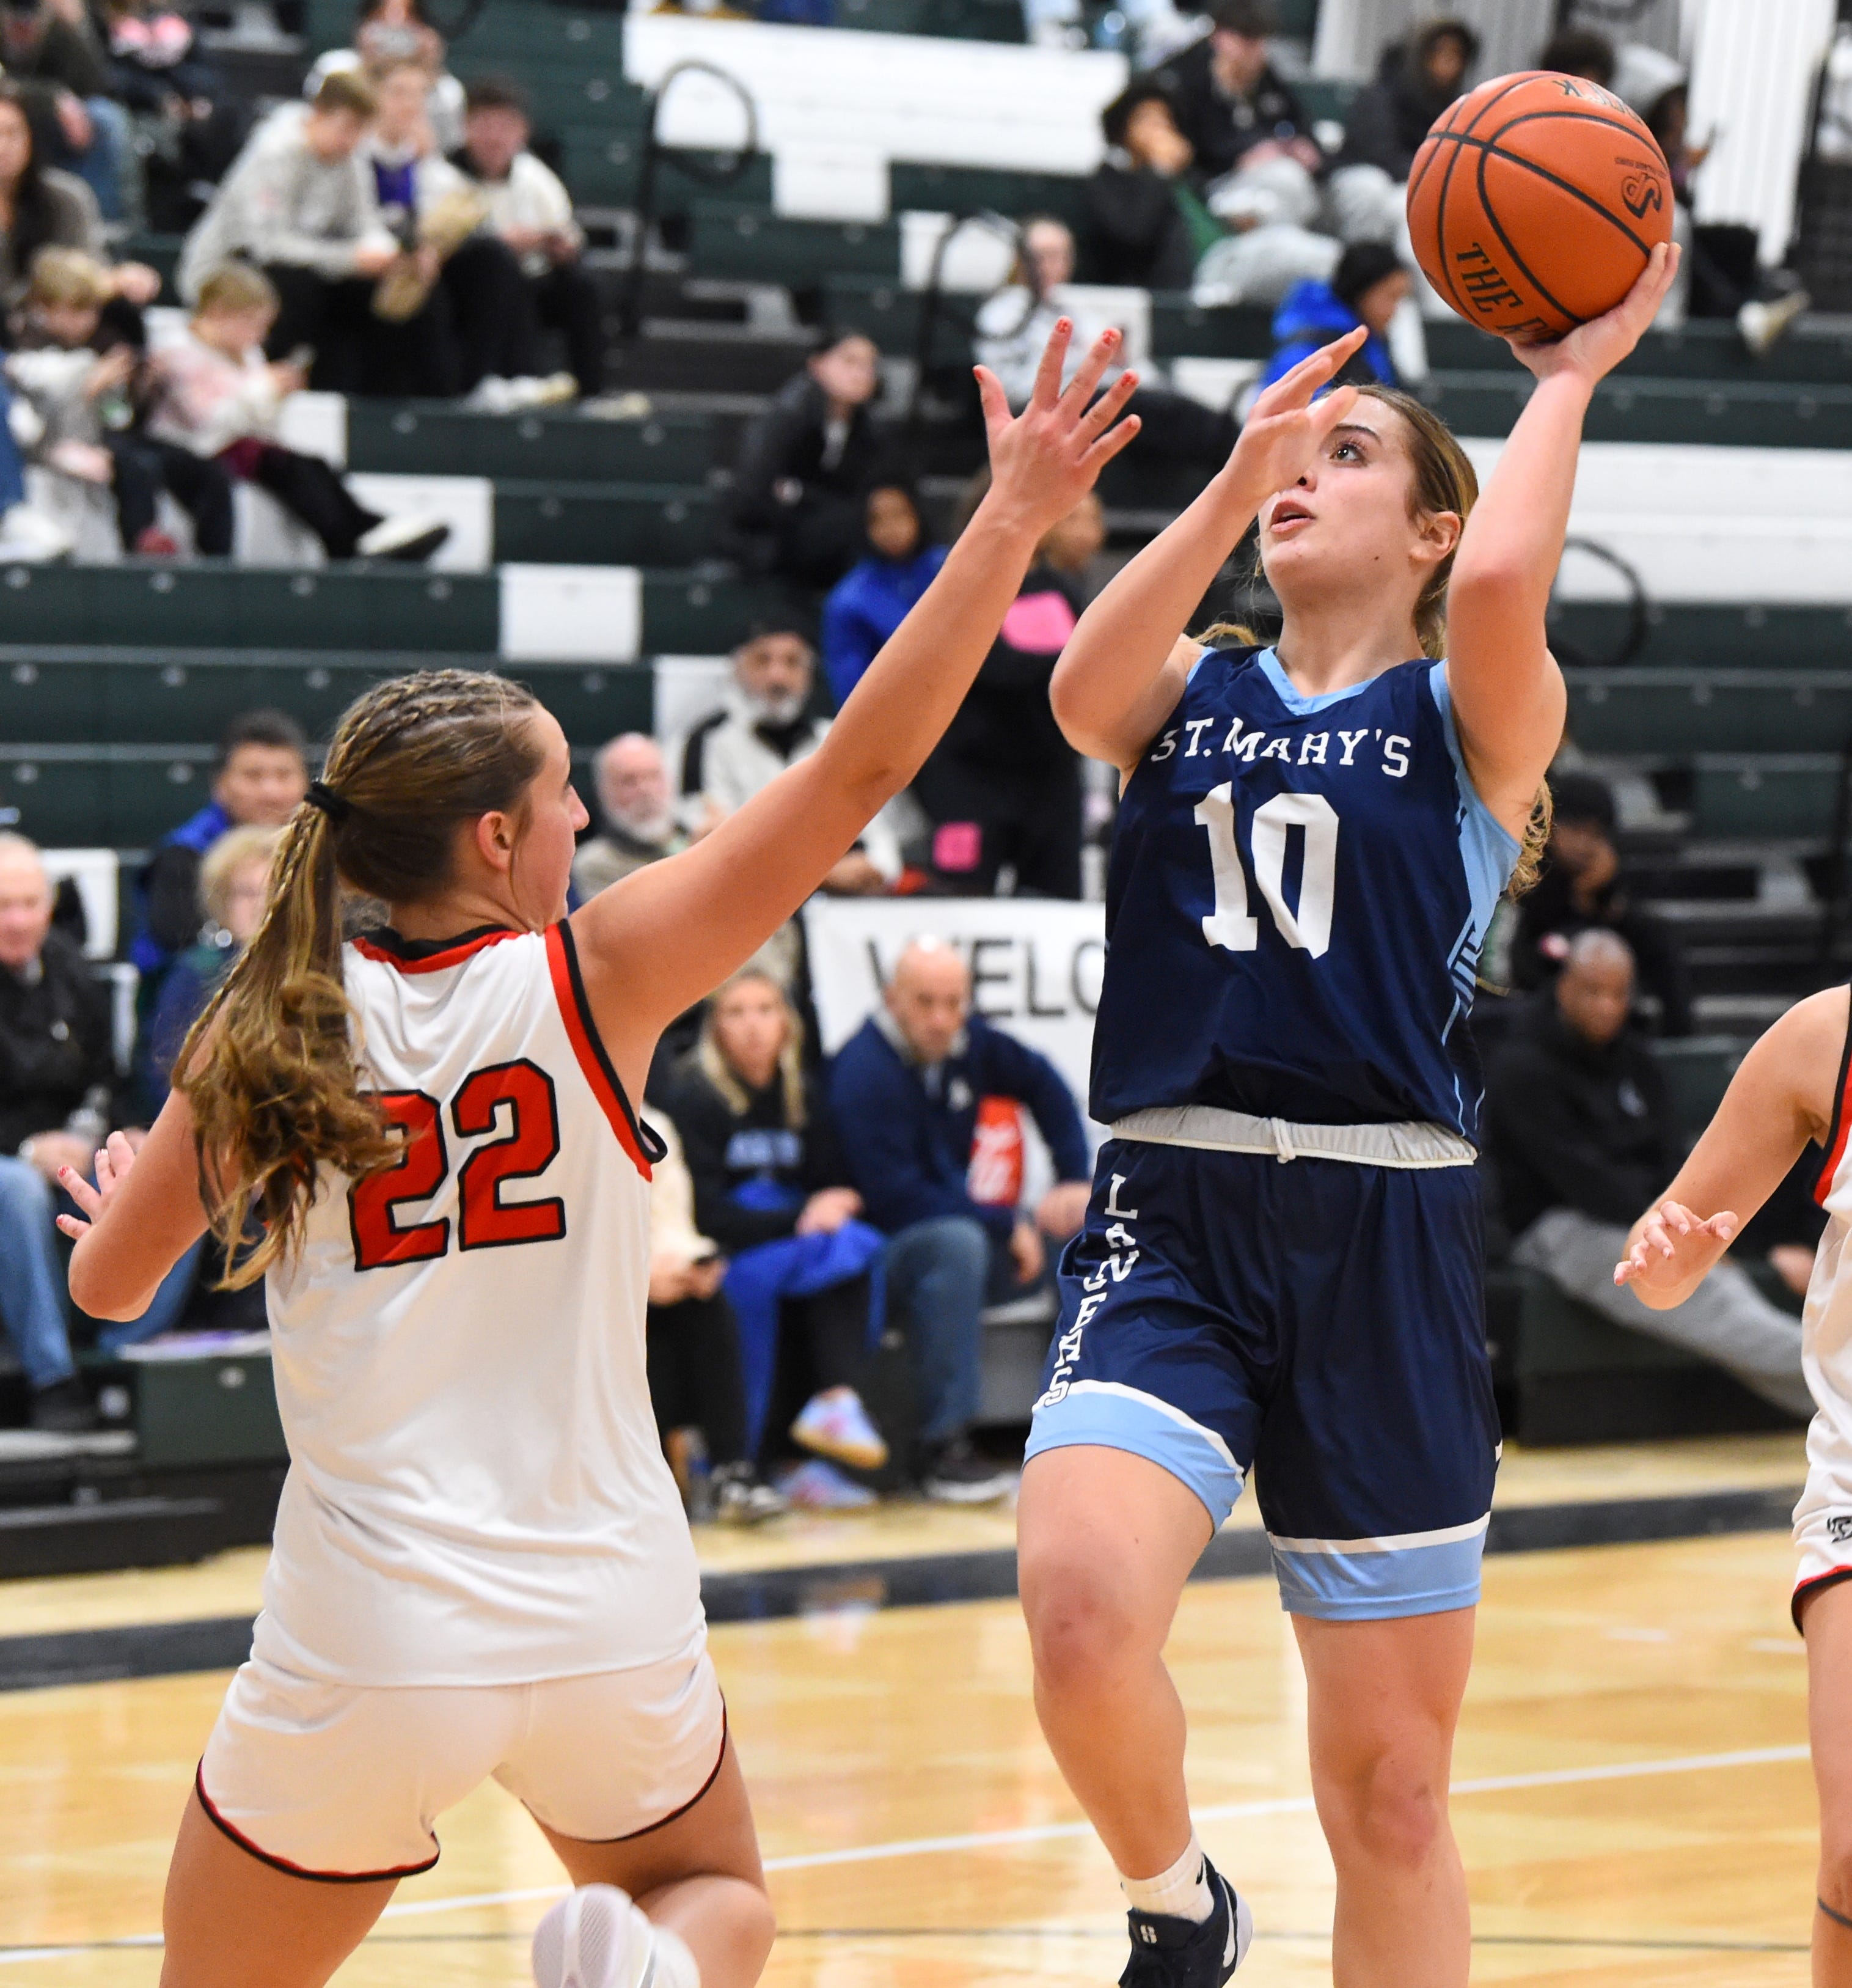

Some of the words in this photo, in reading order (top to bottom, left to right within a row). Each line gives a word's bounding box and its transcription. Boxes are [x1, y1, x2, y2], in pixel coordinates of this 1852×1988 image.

[1457, 242, 1524, 313] THE
[1193, 780, 1339, 959] 10
[347, 1057, 566, 1272] 22
